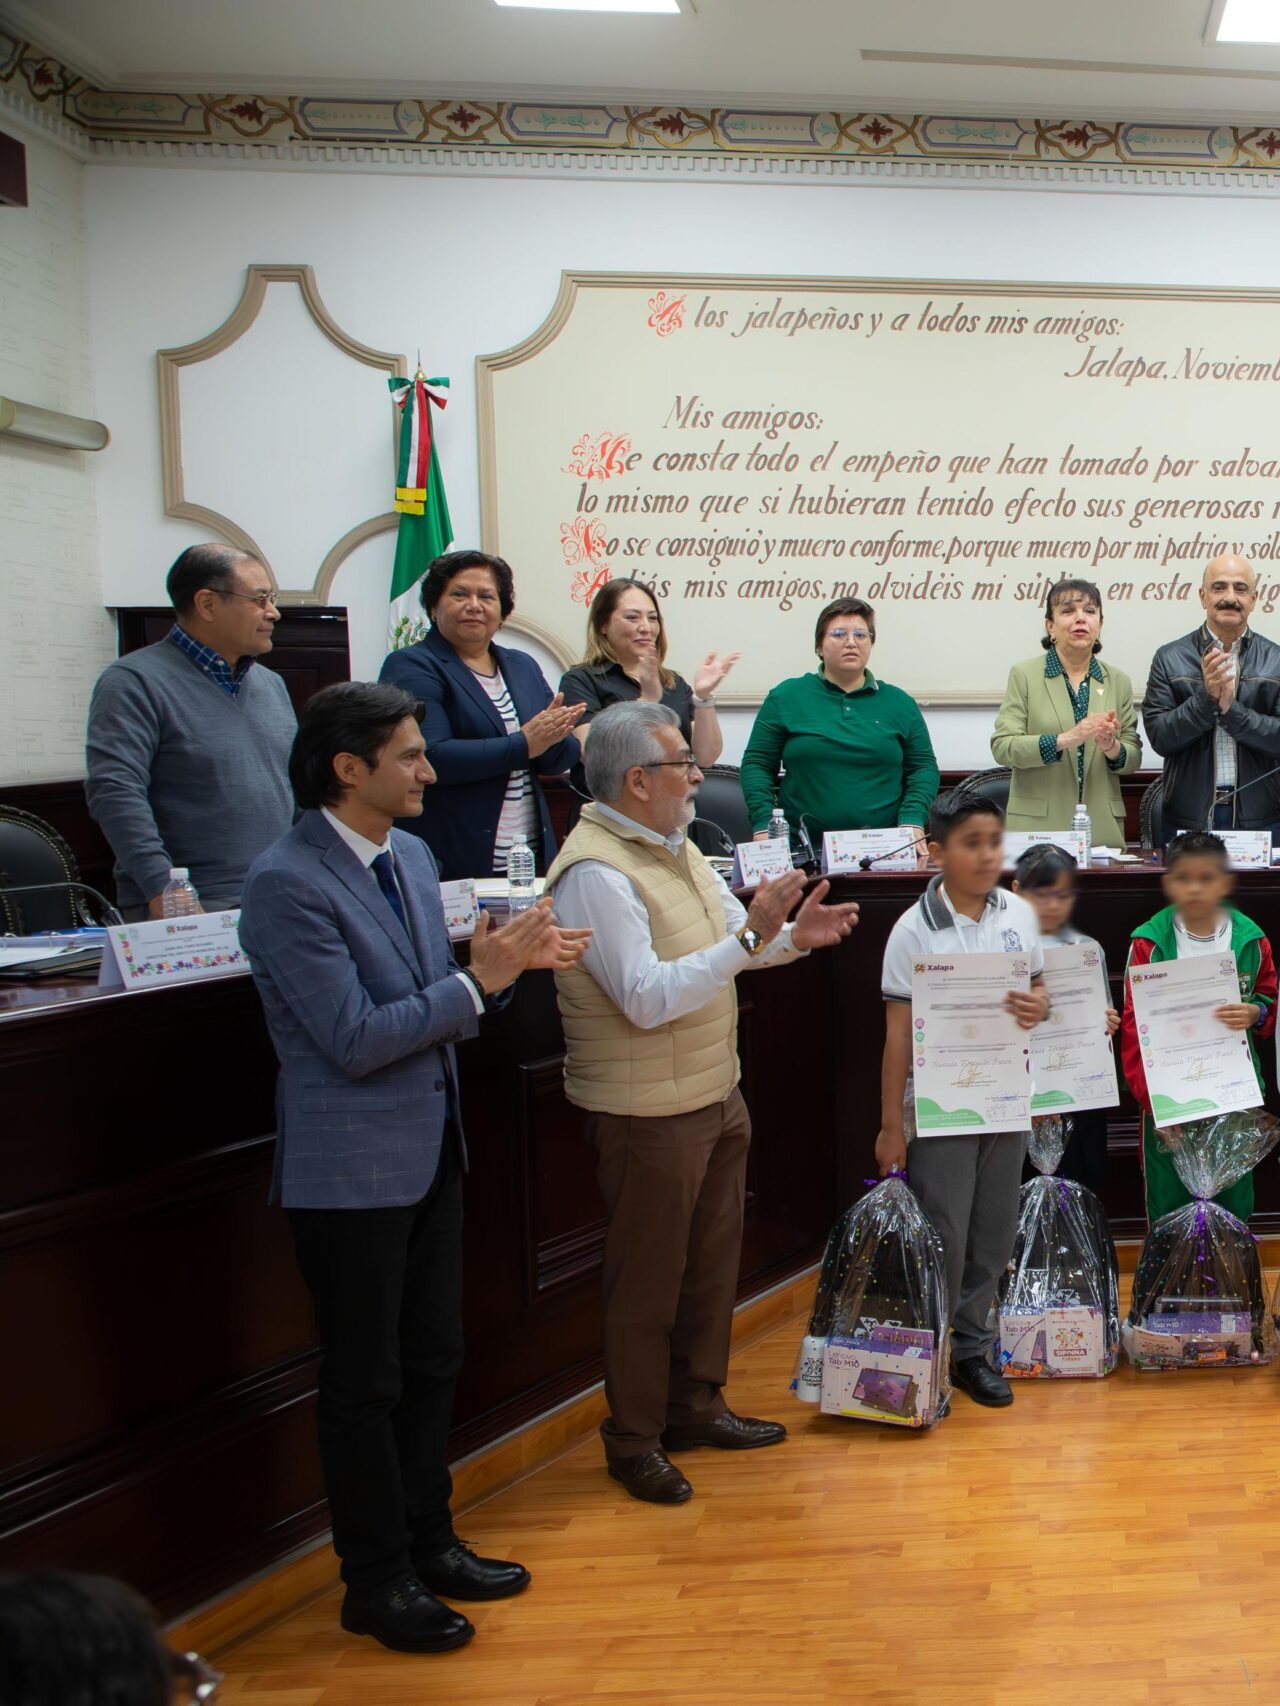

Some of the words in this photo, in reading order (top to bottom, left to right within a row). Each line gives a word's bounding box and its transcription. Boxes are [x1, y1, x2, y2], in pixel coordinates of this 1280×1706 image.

[695, 296, 728, 328] los
[731, 298, 863, 337] jalapeños
[866, 313, 883, 338] y
[890, 314, 910, 331] a
[917, 301, 981, 333] todos
[985, 309, 1028, 334] mis
[1033, 310, 1124, 343] amigos:
[662, 396, 714, 428] Mis
[722, 404, 823, 440] amigos:
[653, 439, 740, 471] consta
[746, 442, 799, 472] todo
[810, 441, 839, 472] el
[843, 450, 941, 482] empeño
[948, 456, 990, 483] que
[997, 443, 1048, 474] han
[1059, 444, 1148, 476] tomado
[1153, 455, 1199, 483] por
[577, 482, 598, 513] lo
[605, 487, 689, 513] mismo
[700, 495, 748, 522] que
[759, 487, 782, 514] si
[788, 484, 906, 516] hubieran
[917, 486, 993, 517] tenido
[1005, 487, 1076, 524] efecto
[1084, 499, 1126, 518] sus
[1129, 498, 1264, 528] generosas
[623, 537, 650, 556] se
[758, 539, 776, 564] y
[778, 539, 846, 557] muero
[944, 536, 1022, 567] porque
[1027, 541, 1091, 559] muero
[1091, 536, 1132, 566] por
[1133, 534, 1161, 559] mi
[1158, 532, 1228, 566] patria
[684, 571, 727, 598] mis
[830, 581, 860, 600] no
[971, 575, 1006, 600] mi
[1107, 583, 1133, 600] en
[1141, 573, 1192, 600] esta
[927, 964, 954, 972] Xalapa
[828, 1350, 855, 1361] Lenovo
[844, 1360, 860, 1368] M10
